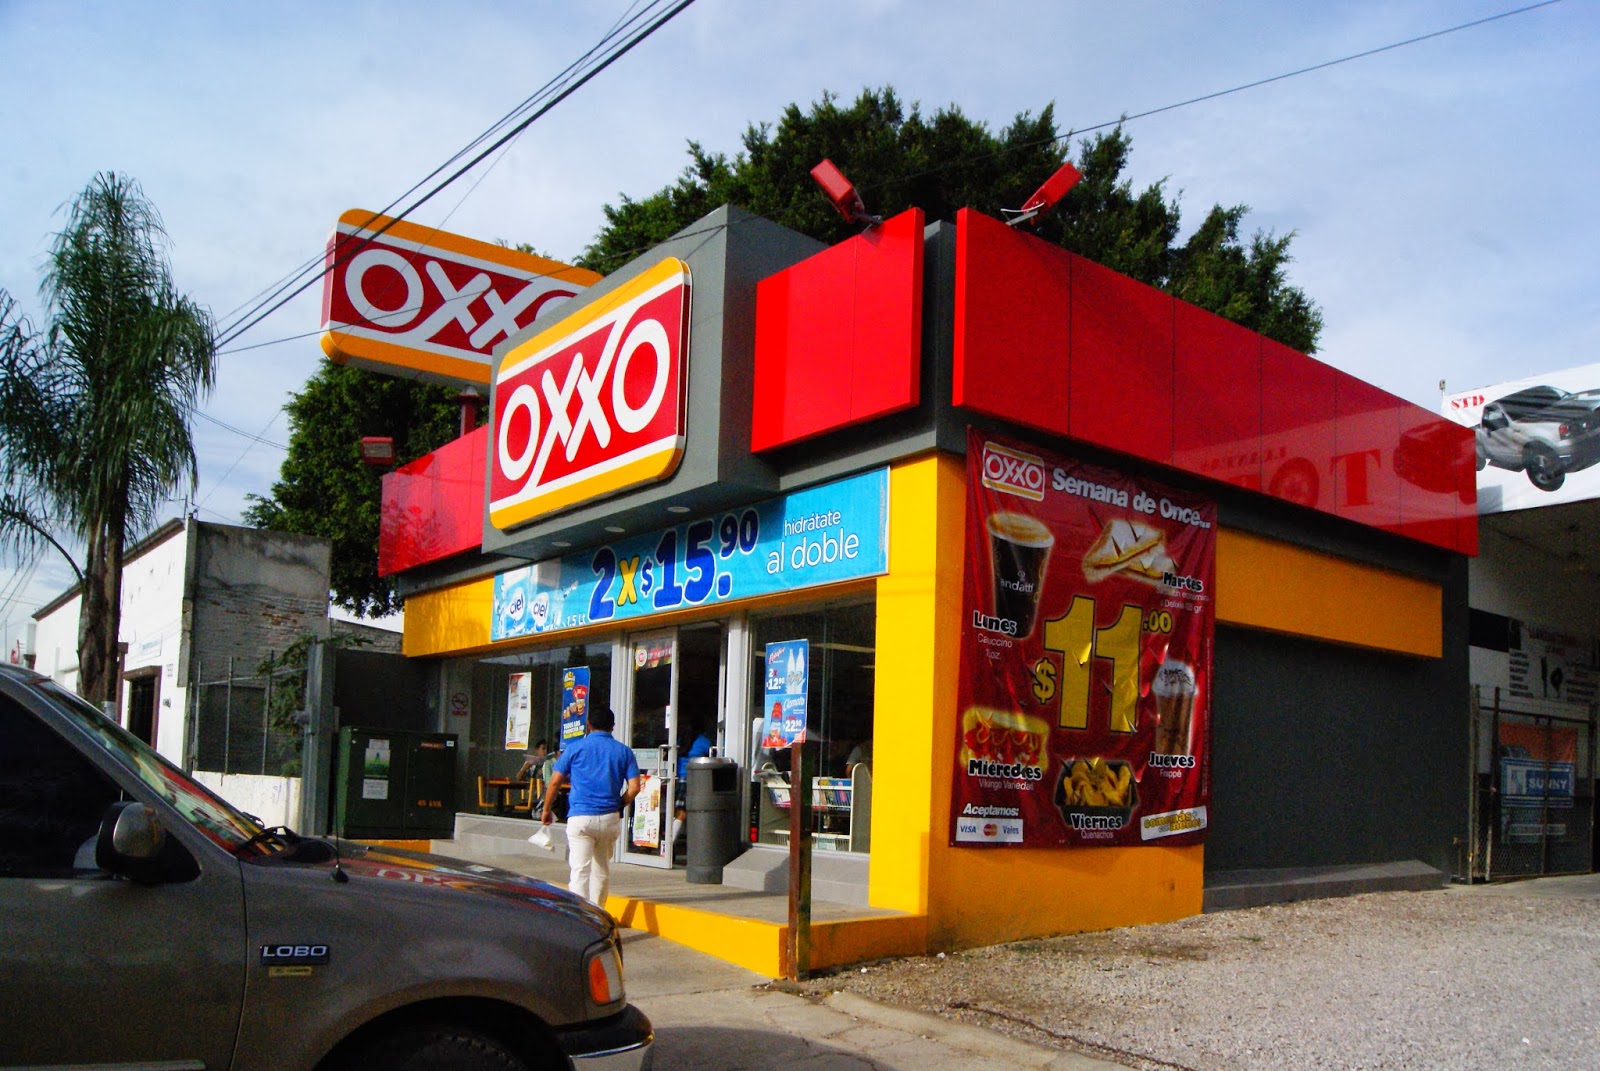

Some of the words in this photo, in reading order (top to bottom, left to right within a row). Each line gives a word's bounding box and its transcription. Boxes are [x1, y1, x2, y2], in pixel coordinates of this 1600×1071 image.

[499, 318, 671, 485] OXXO
[985, 454, 1043, 489] OXXO
[1051, 468, 1129, 508] Semana
[1133, 491, 1157, 514] de
[784, 509, 842, 537] hidrátate
[766, 547, 785, 575] al
[791, 528, 860, 569] doble
[1148, 751, 1196, 769] Jueves
[1528, 777, 1567, 790] SUNY
[960, 825, 977, 834] VISA
[1002, 825, 1020, 835] Vales
[1070, 813, 1123, 830] Viernes
[262, 945, 328, 958] LOBO
